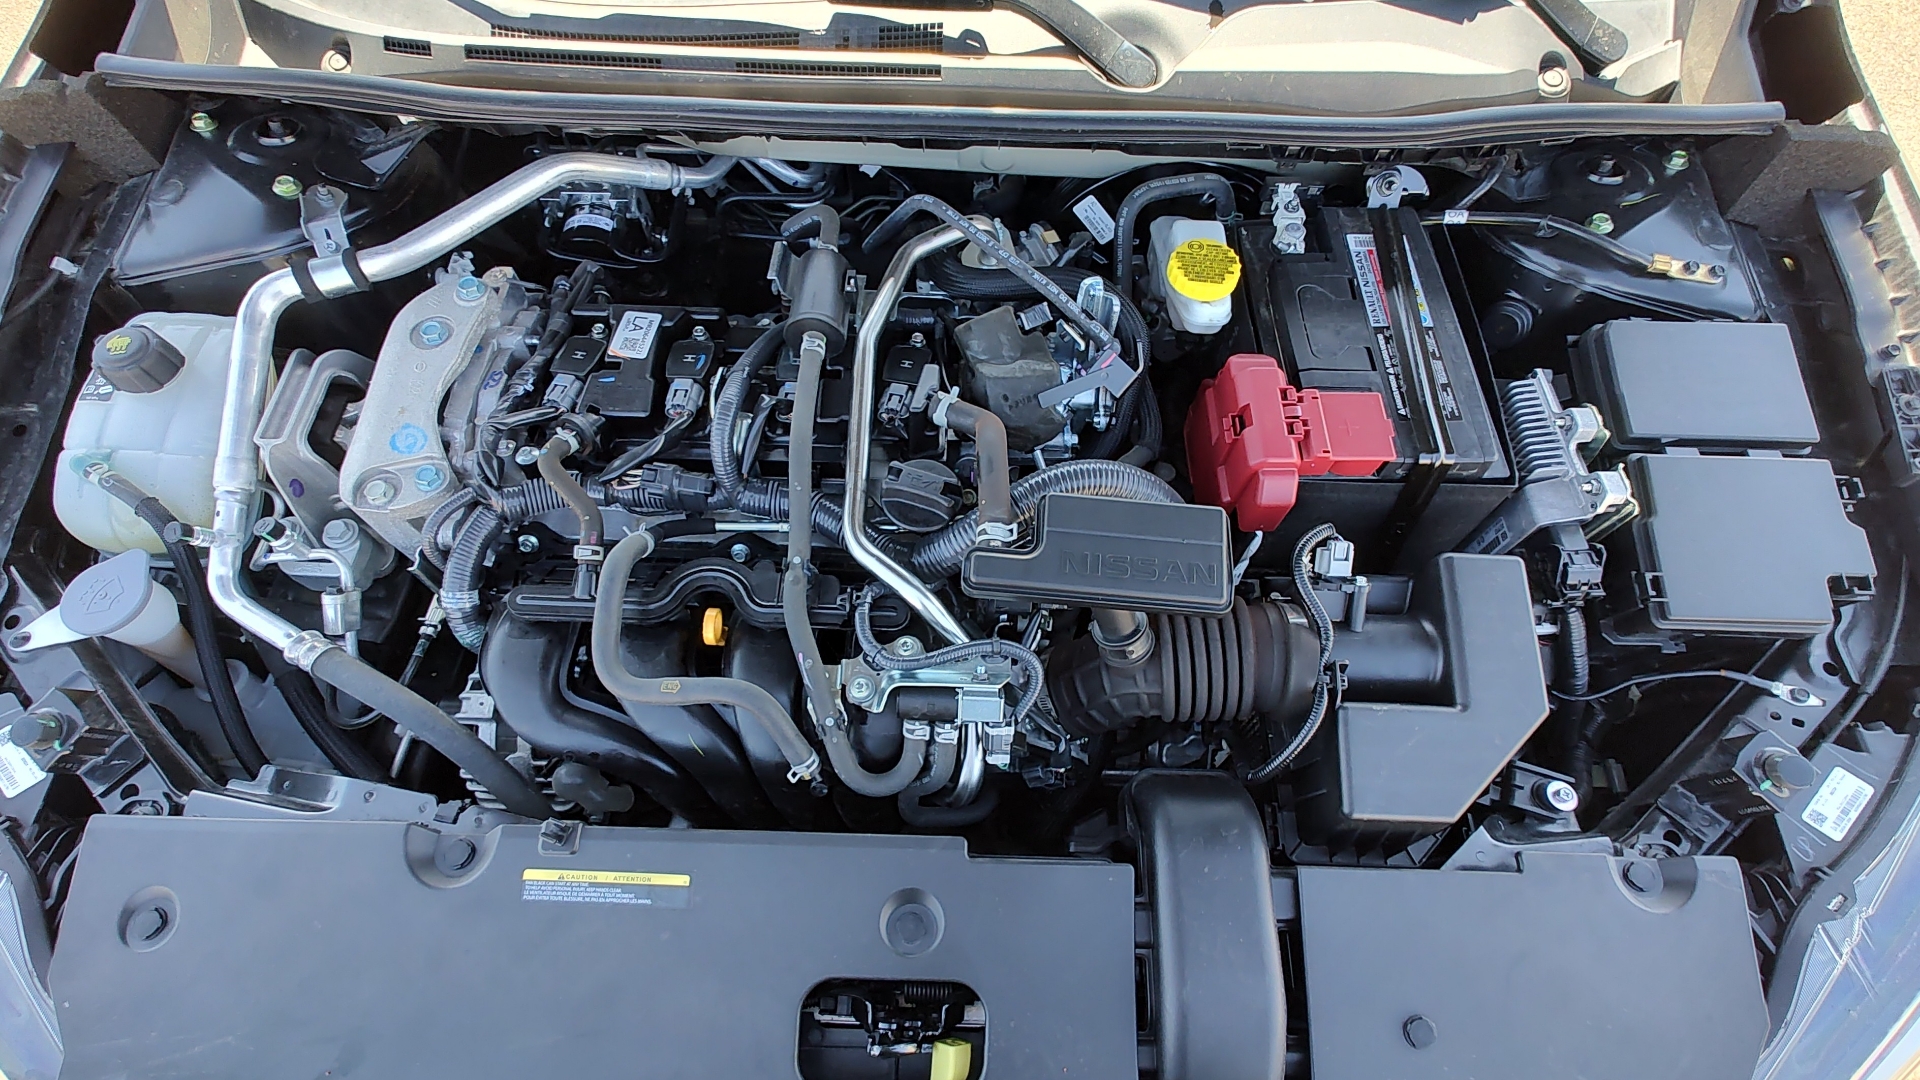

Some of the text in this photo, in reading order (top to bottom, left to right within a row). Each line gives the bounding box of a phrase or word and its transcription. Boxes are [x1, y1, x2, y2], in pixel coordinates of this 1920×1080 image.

[1353, 251, 1371, 288] NISSAN
[628, 316, 648, 332] LA
[1364, 290, 1381, 324] RENAULT
[1061, 550, 1217, 586] NISSAN
